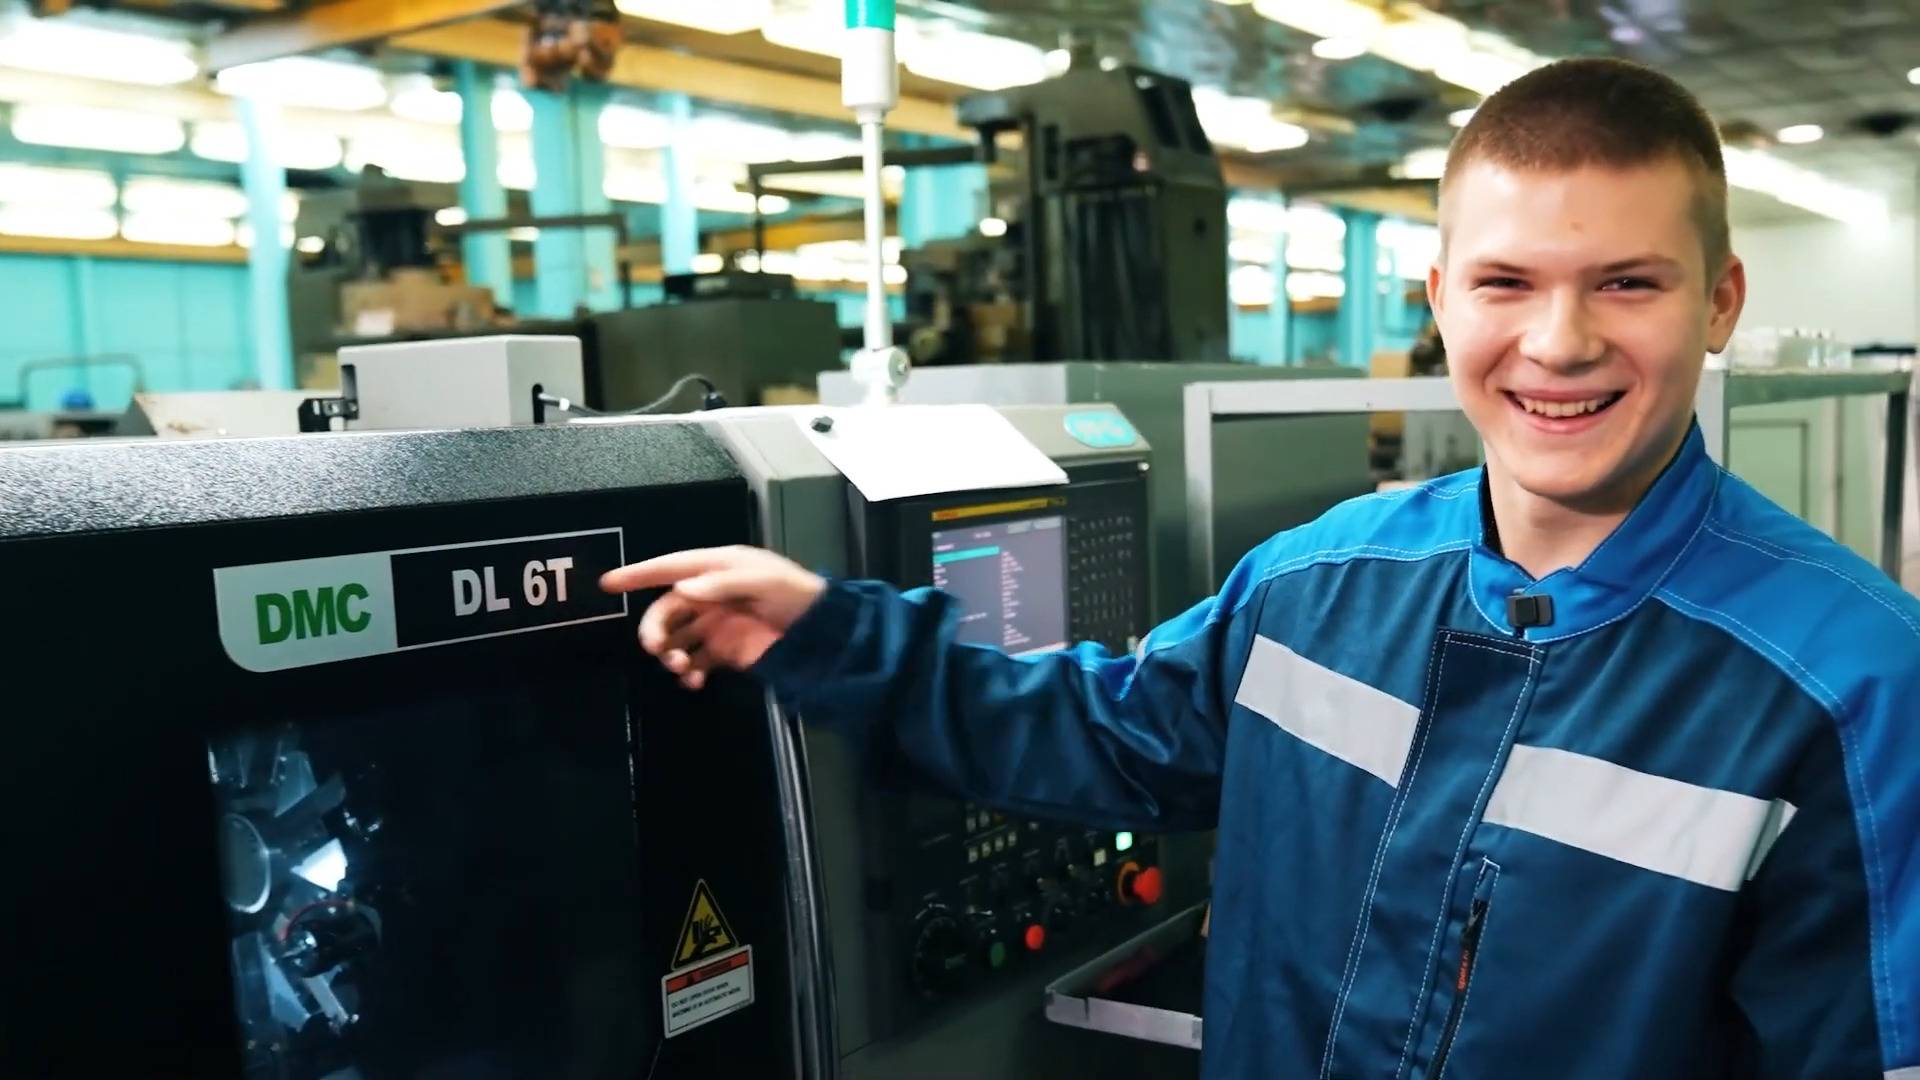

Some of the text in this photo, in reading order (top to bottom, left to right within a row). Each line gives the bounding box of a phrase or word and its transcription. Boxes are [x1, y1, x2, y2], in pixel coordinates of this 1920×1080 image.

[255, 556, 574, 645] DMC DL 6T
